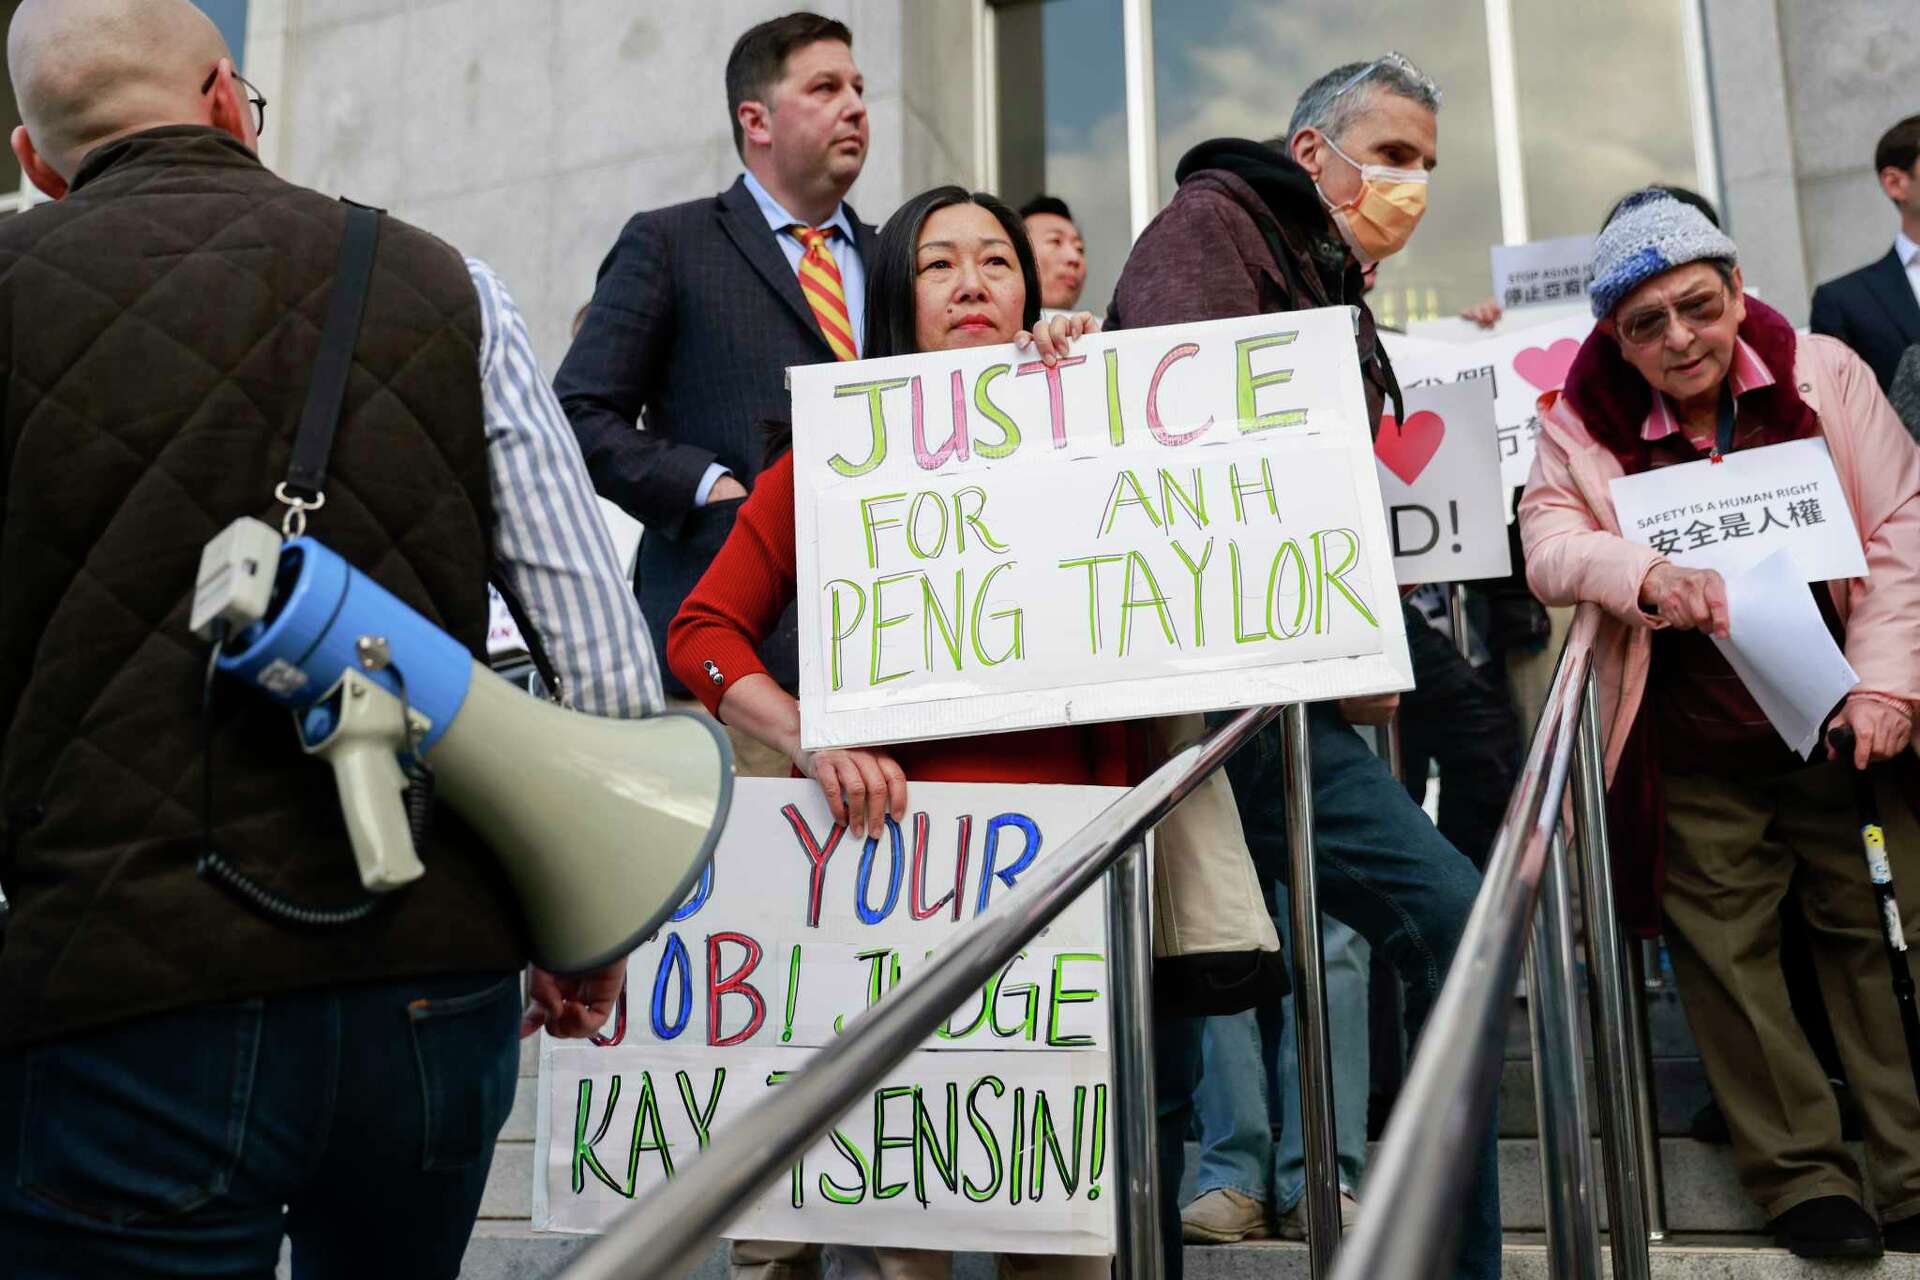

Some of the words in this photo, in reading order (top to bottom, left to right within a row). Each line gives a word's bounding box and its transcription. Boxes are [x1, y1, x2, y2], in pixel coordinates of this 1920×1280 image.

[827, 330, 1308, 478] JUSTICE
[860, 486, 1010, 568] FOR
[1637, 507, 1687, 529] SAFETY
[1690, 503, 1704, 514] IS
[1705, 501, 1716, 511] A
[1719, 491, 1774, 509] HUMAN
[1776, 481, 1820, 498] RIGHT
[1648, 498, 1826, 556] 安全是人權
[824, 561, 1025, 692] PENG
[1058, 527, 1381, 658] TAYLOR
[781, 803, 1048, 936] YOUR
[834, 948, 1105, 1047] JDGE
[571, 1067, 726, 1199] KAY
